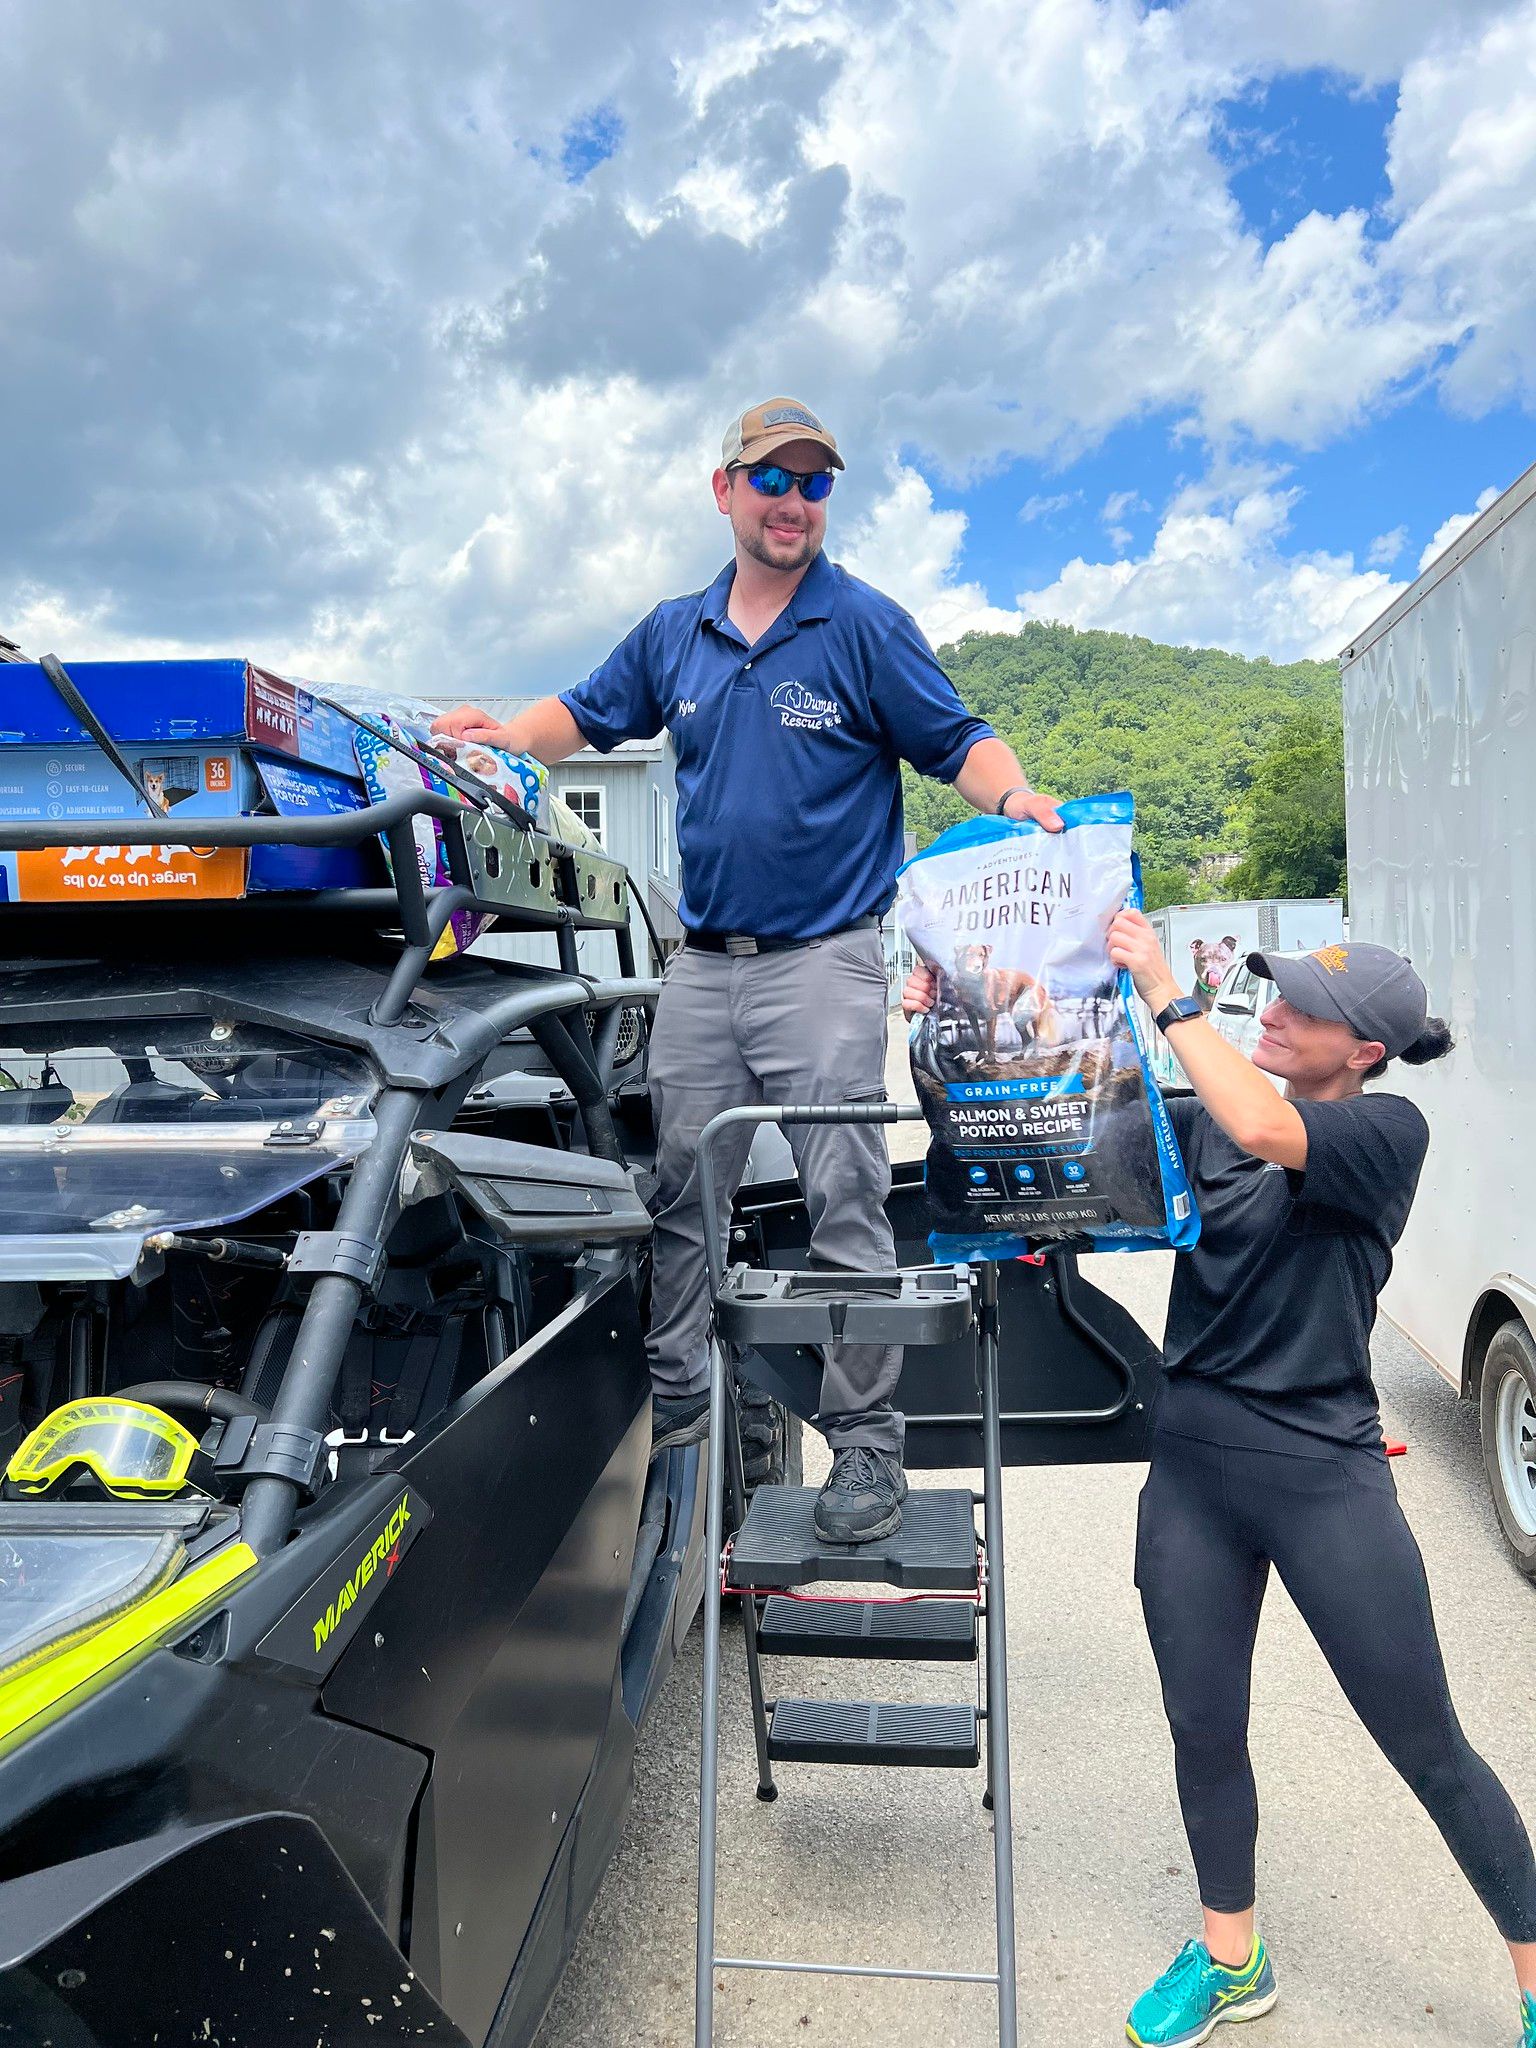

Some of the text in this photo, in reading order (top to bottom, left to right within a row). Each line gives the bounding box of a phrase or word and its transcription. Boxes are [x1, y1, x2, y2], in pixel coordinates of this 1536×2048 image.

[678, 699, 697, 717] Kyle
[803, 691, 838, 714] Dumas
[780, 712, 822, 730] Rescue
[65, 764, 86, 772] SECURE
[210, 762, 225, 779] 36
[355, 725, 387, 806] aboodl
[66, 785, 110, 793] EASY-TO-CLEAN
[66, 806, 125, 814] ADJUSTABLE DIVIDER
[982, 852, 1033, 870] ADVENTURES
[63, 871, 197, 888] Large: Up to 70 lbs
[941, 867, 1072, 910] AMERICAN
[953, 901, 1056, 931] JOURNEY
[964, 1081, 1059, 1097] GRAIN-FREE
[949, 1101, 1088, 1123] SALMON & SWEET
[959, 1117, 1083, 1138] POTATO RECIPE
[1019, 1147, 1039, 1155] ALL
[1019, 1170, 1031, 1179] NO
[1068, 1166, 1079, 1175] 32
[983, 1214, 1001, 1223] NET
[1031, 1212, 1050, 1222] LBS
[312, 1492, 412, 1653] MAVERICK
